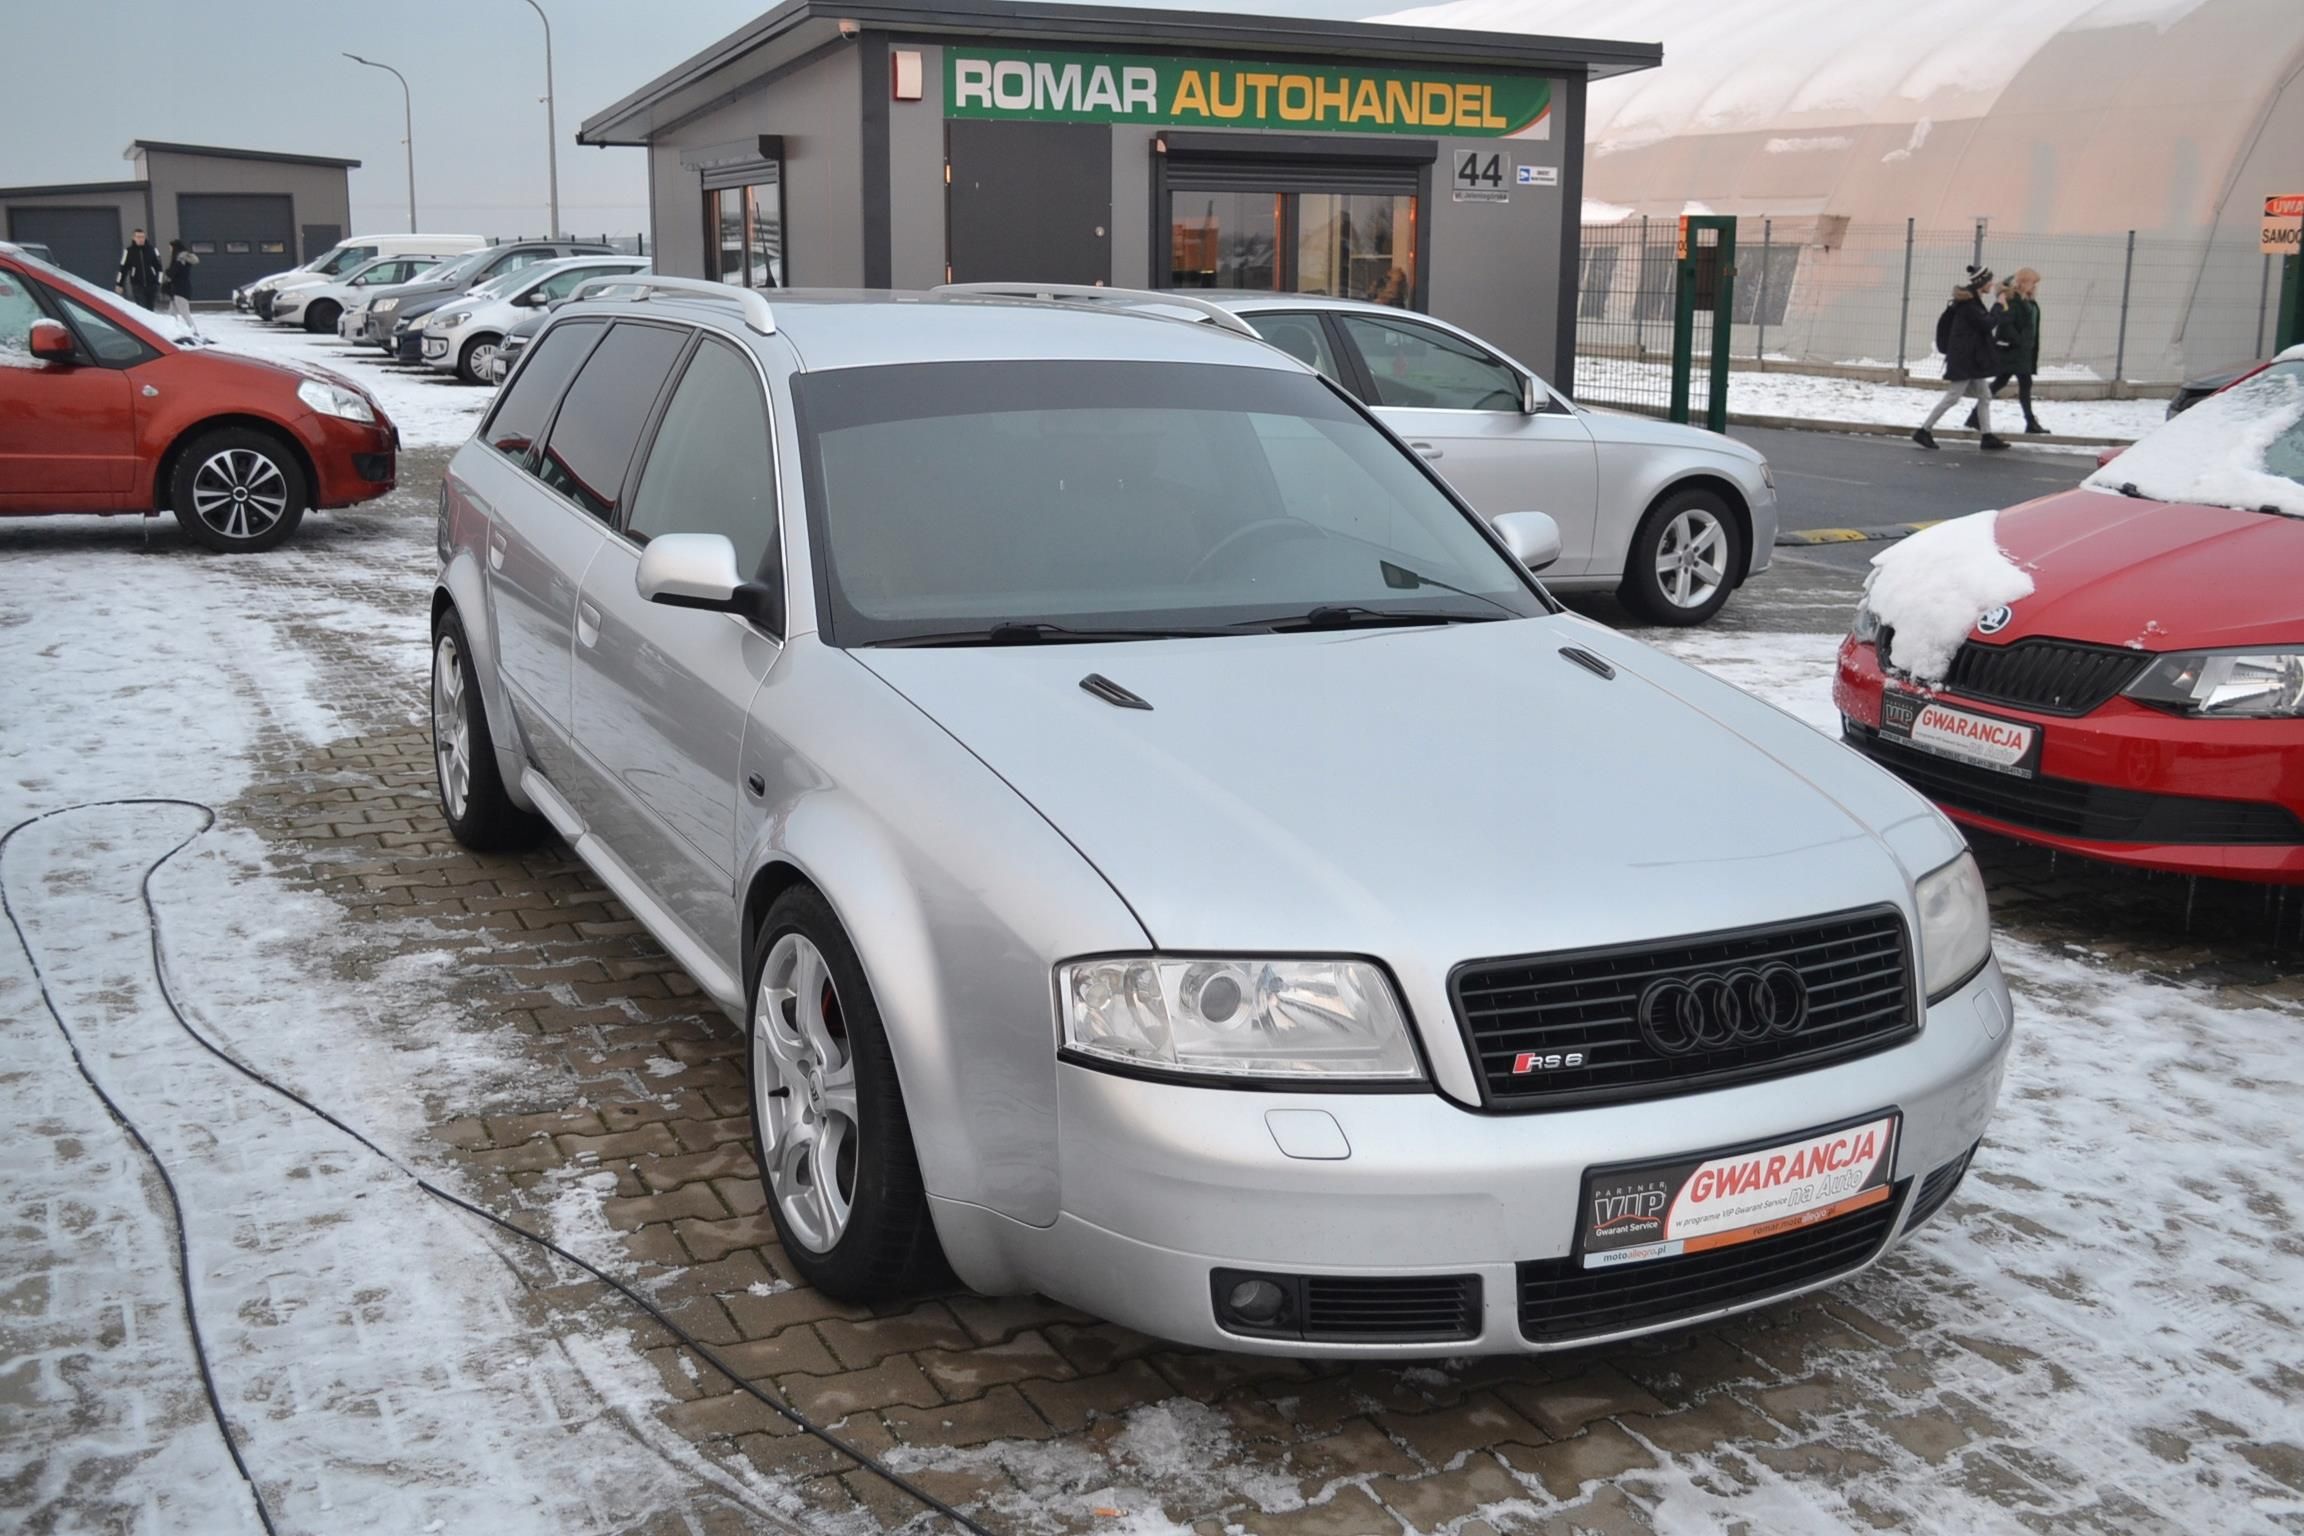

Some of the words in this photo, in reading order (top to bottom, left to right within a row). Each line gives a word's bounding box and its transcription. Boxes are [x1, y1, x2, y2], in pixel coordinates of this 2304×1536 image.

[955, 58, 1158, 115] ROMAR
[1171, 69, 1508, 129] AUTOHANDEL
[1458, 152, 1502, 188] 44
[1922, 709, 2022, 750] GWARANCJA
[1690, 1130, 1875, 1204] GWARANCJA
[1595, 1181, 1665, 1198] PARTNER
[1788, 1184, 1815, 1207] na
[1816, 1169, 1863, 1200] Auto
[1595, 1191, 1666, 1226] VIP
[1683, 1212, 1720, 1228] programie
[1763, 1197, 1788, 1210] Service
[1596, 1225, 1629, 1237] Gwarant
[1630, 1221, 1658, 1232] Service
[1603, 1245, 1666, 1262] motoallegro.pl
